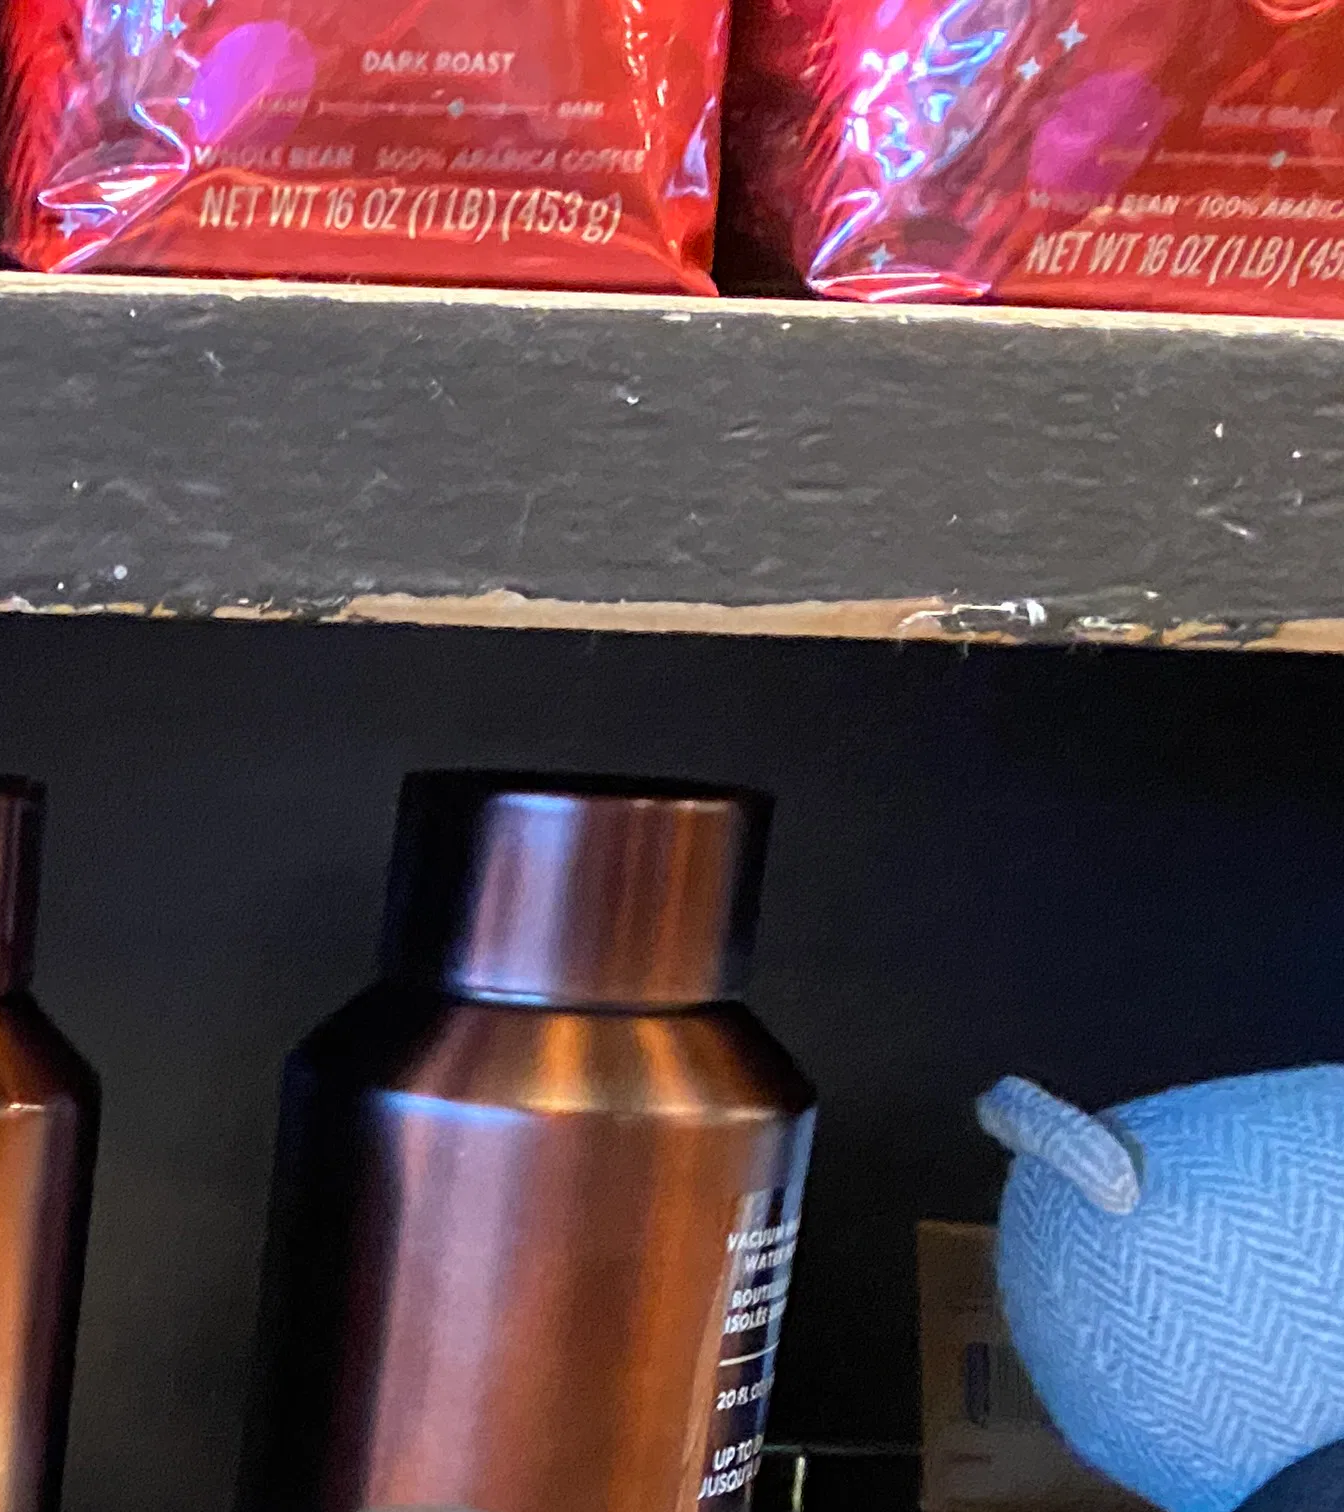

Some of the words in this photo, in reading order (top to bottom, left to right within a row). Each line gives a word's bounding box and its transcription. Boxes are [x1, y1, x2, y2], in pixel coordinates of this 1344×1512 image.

[362, 50, 430, 75] DARK
[434, 51, 515, 76] ROAST
[198, 185, 263, 230] NET
[268, 185, 321, 229] WT
[324, 186, 358, 230] 16
[363, 186, 407, 230] OZ
[501, 187, 584, 243] (453
[580, 190, 623, 245] g)
[1116, 194, 1181, 217] BEAN
[1259, 196, 1344, 220] ARABIC
[1026, 230, 1095, 276] NET
[1087, 231, 1143, 275] WT
[1136, 232, 1176, 276] 16
[1169, 233, 1219, 278] OZ
[1286, 237, 1344, 289] (45
[715, 1388, 737, 1411] 20
[713, 1446, 736, 1472] UP
